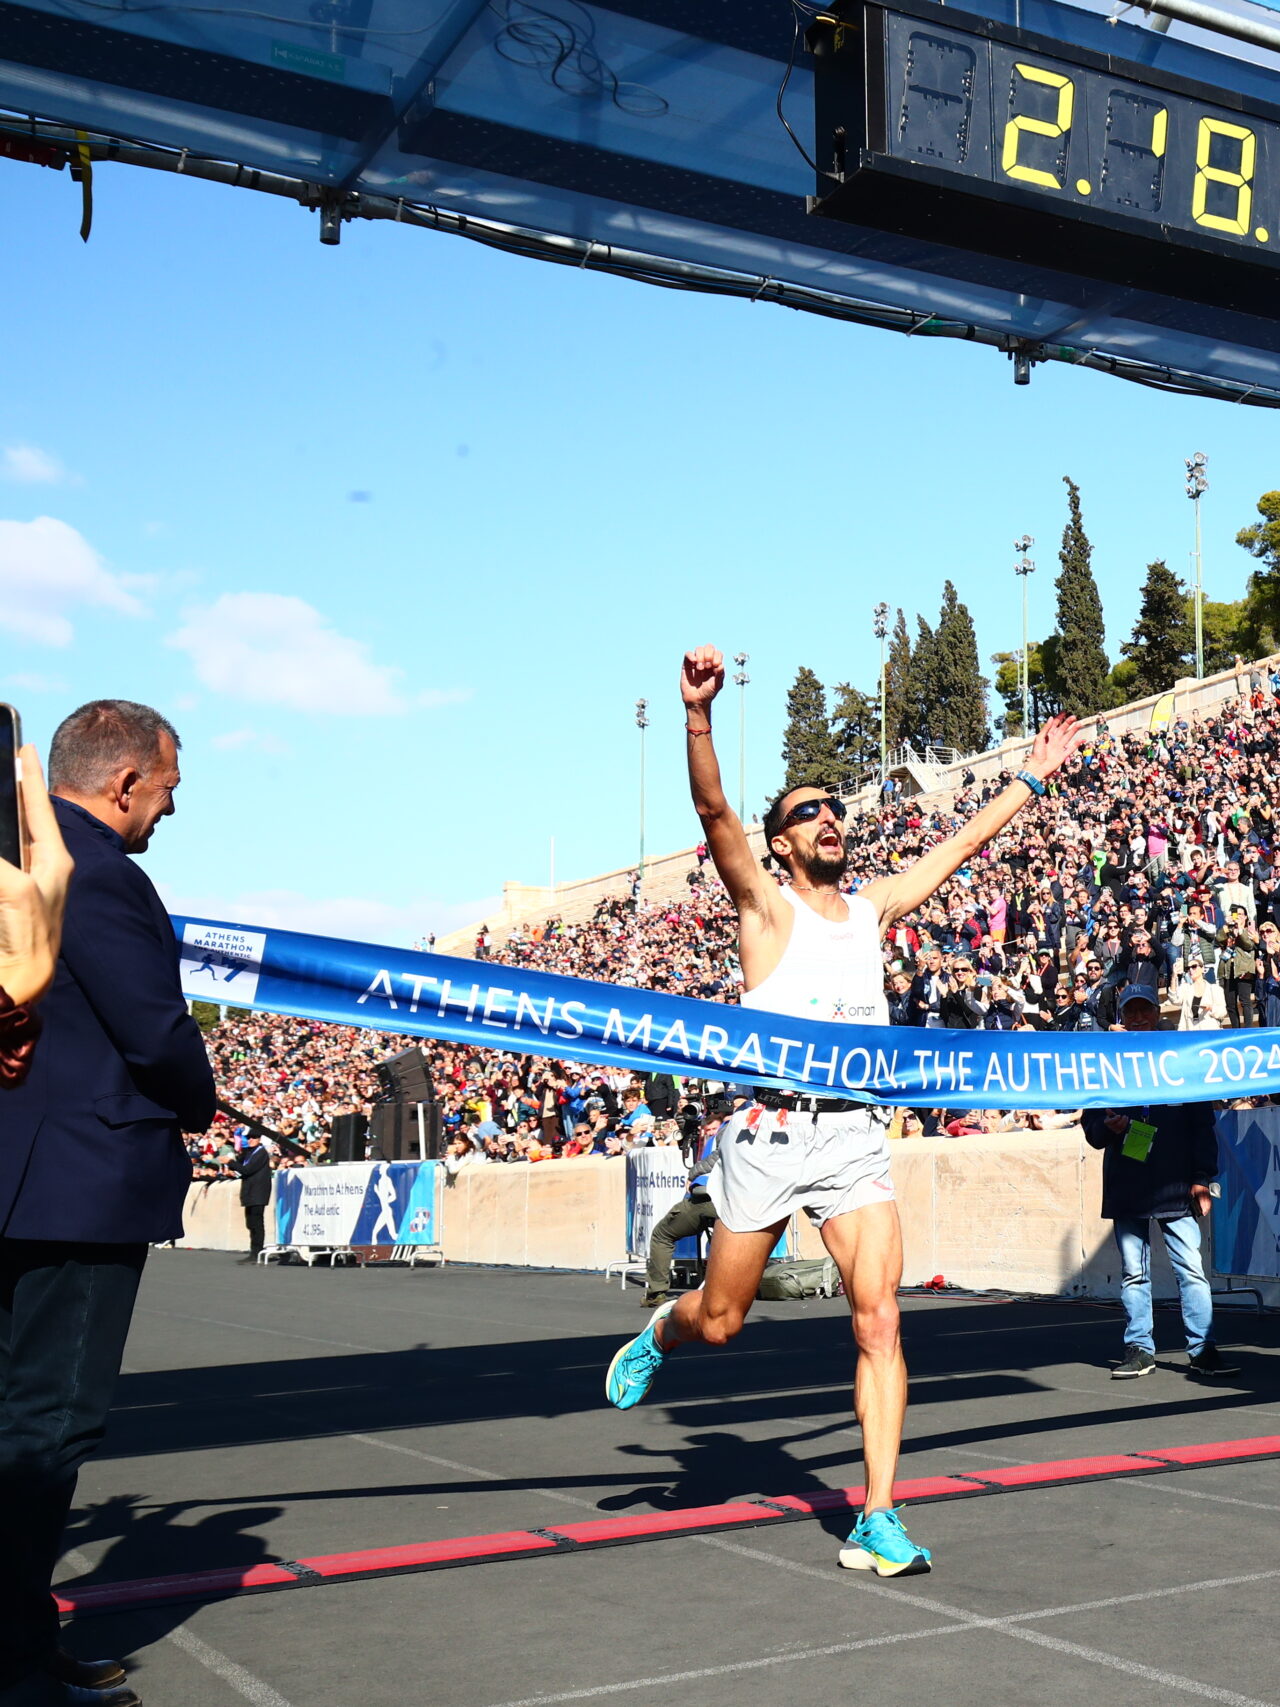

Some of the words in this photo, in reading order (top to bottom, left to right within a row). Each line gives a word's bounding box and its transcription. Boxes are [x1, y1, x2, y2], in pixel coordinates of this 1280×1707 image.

[205, 931, 246, 943] ATHENS
[193, 938, 253, 953] MARATHON
[356, 968, 587, 1040] ATHENS
[913, 1050, 974, 1092] THE
[982, 1050, 1185, 1092] AUTHENTIC
[649, 1171, 686, 1188] Athens
